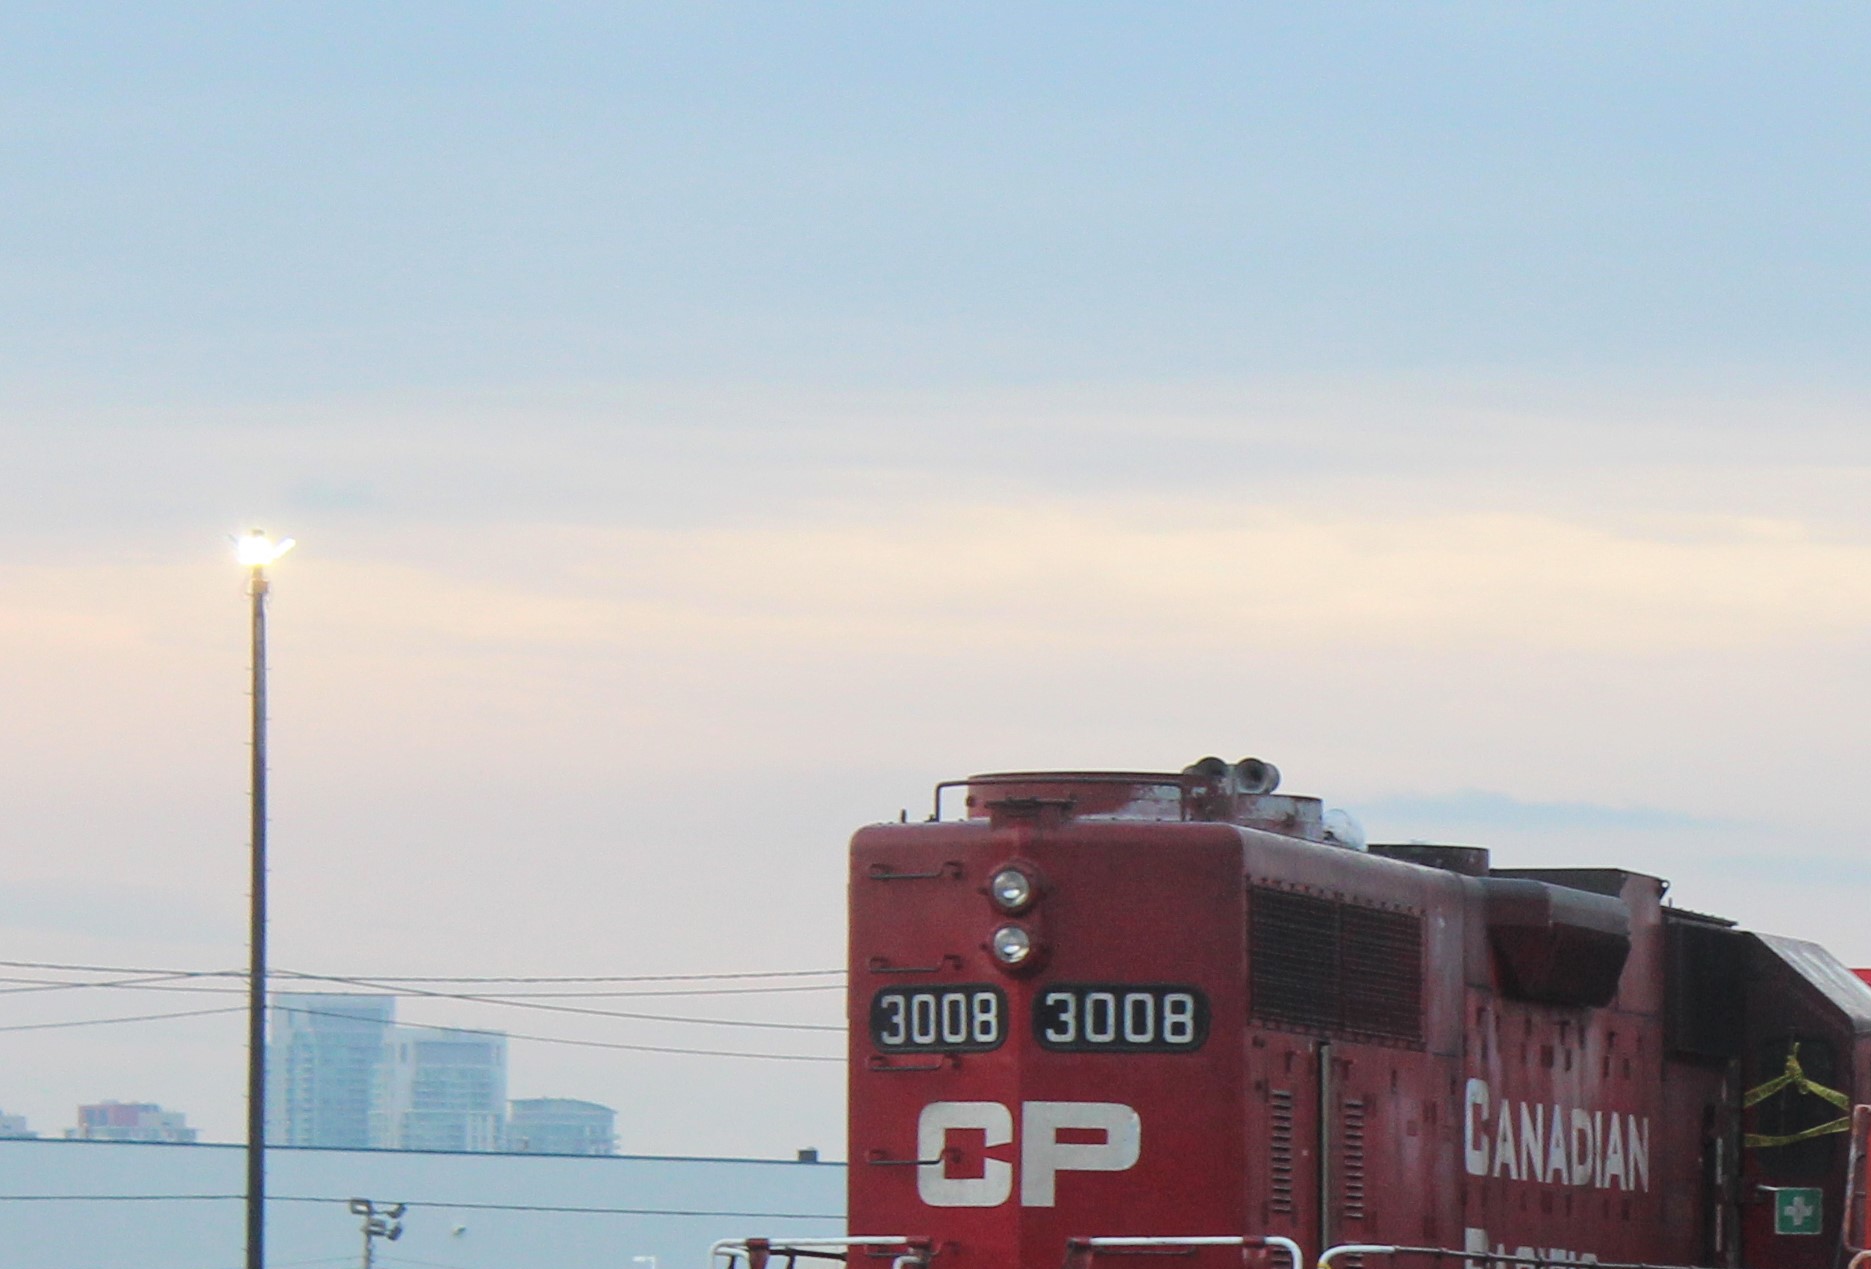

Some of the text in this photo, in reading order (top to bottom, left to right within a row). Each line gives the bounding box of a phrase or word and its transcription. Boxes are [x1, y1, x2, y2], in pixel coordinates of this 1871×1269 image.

[880, 992, 998, 1045] 3008
[1045, 992, 1195, 1043] 3008
[917, 1100, 1142, 1208] CP
[1464, 1077, 1649, 1193] CANADIAN
